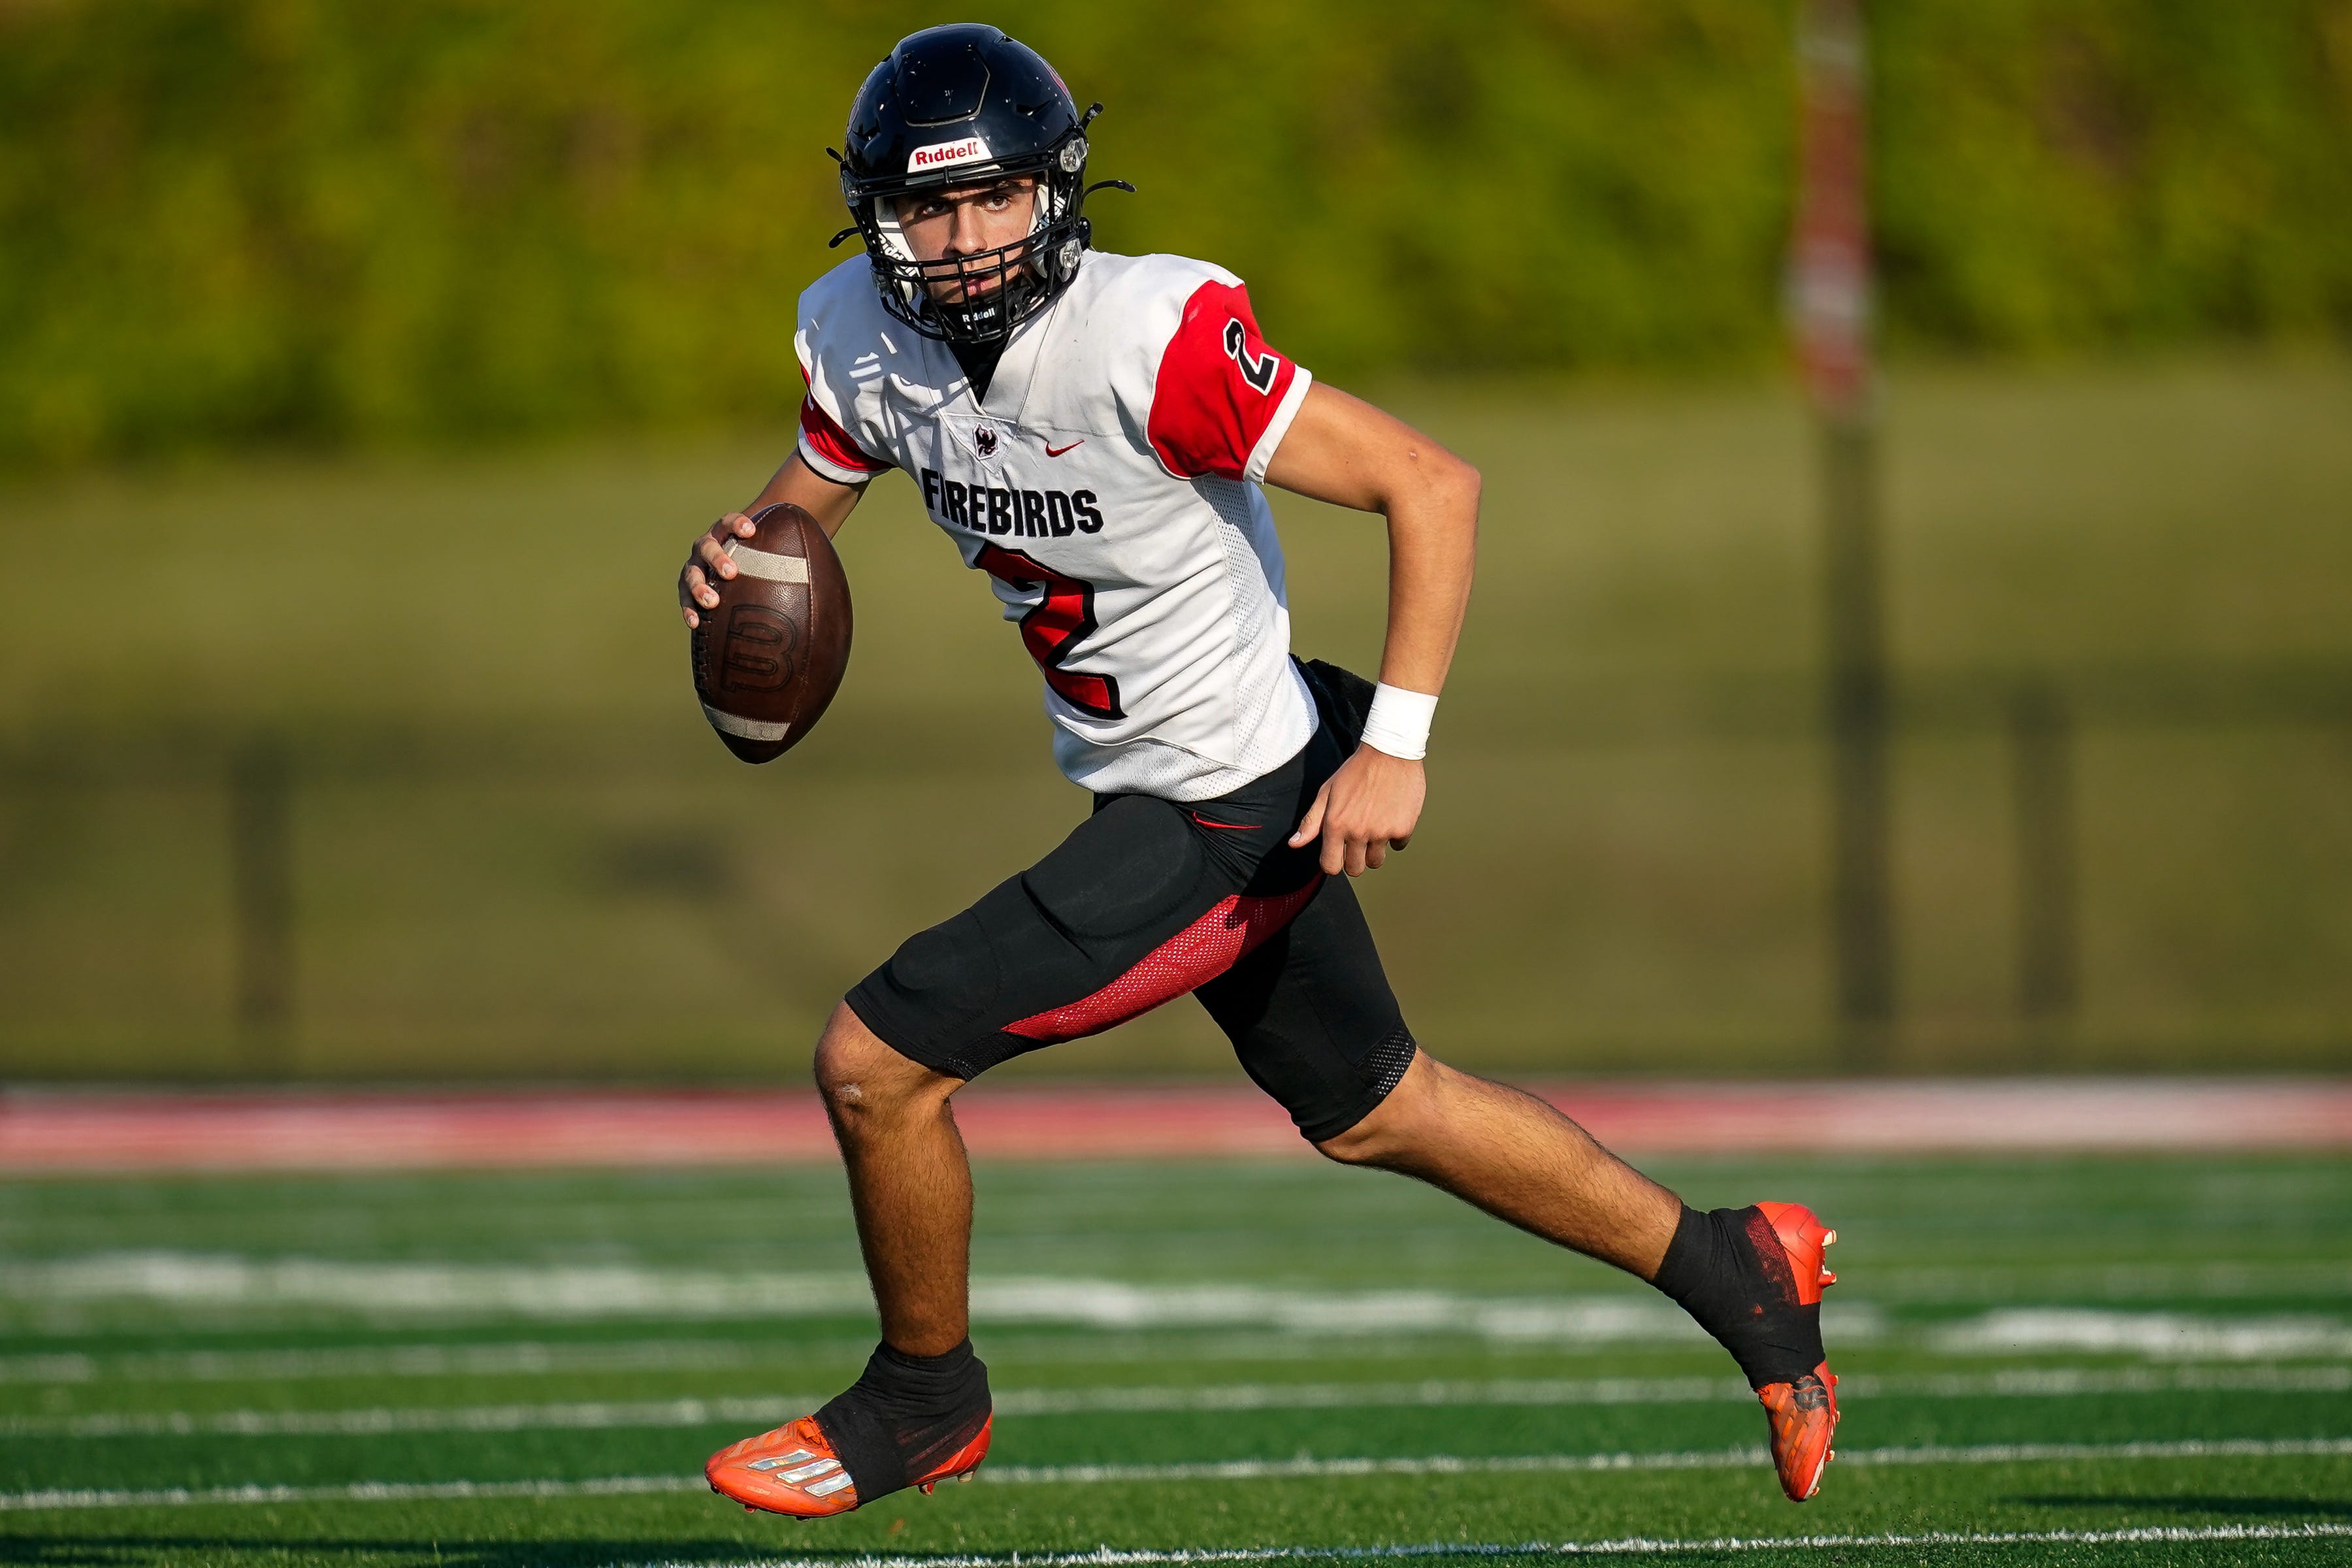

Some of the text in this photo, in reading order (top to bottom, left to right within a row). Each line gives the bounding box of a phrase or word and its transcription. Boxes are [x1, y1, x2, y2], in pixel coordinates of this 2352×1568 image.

[915, 142, 978, 165] Riddell
[962, 307, 995, 322] Rddell
[1223, 317, 1280, 396] 2
[921, 467, 1104, 538] FIREBIRDS
[973, 540, 1129, 720] 2
